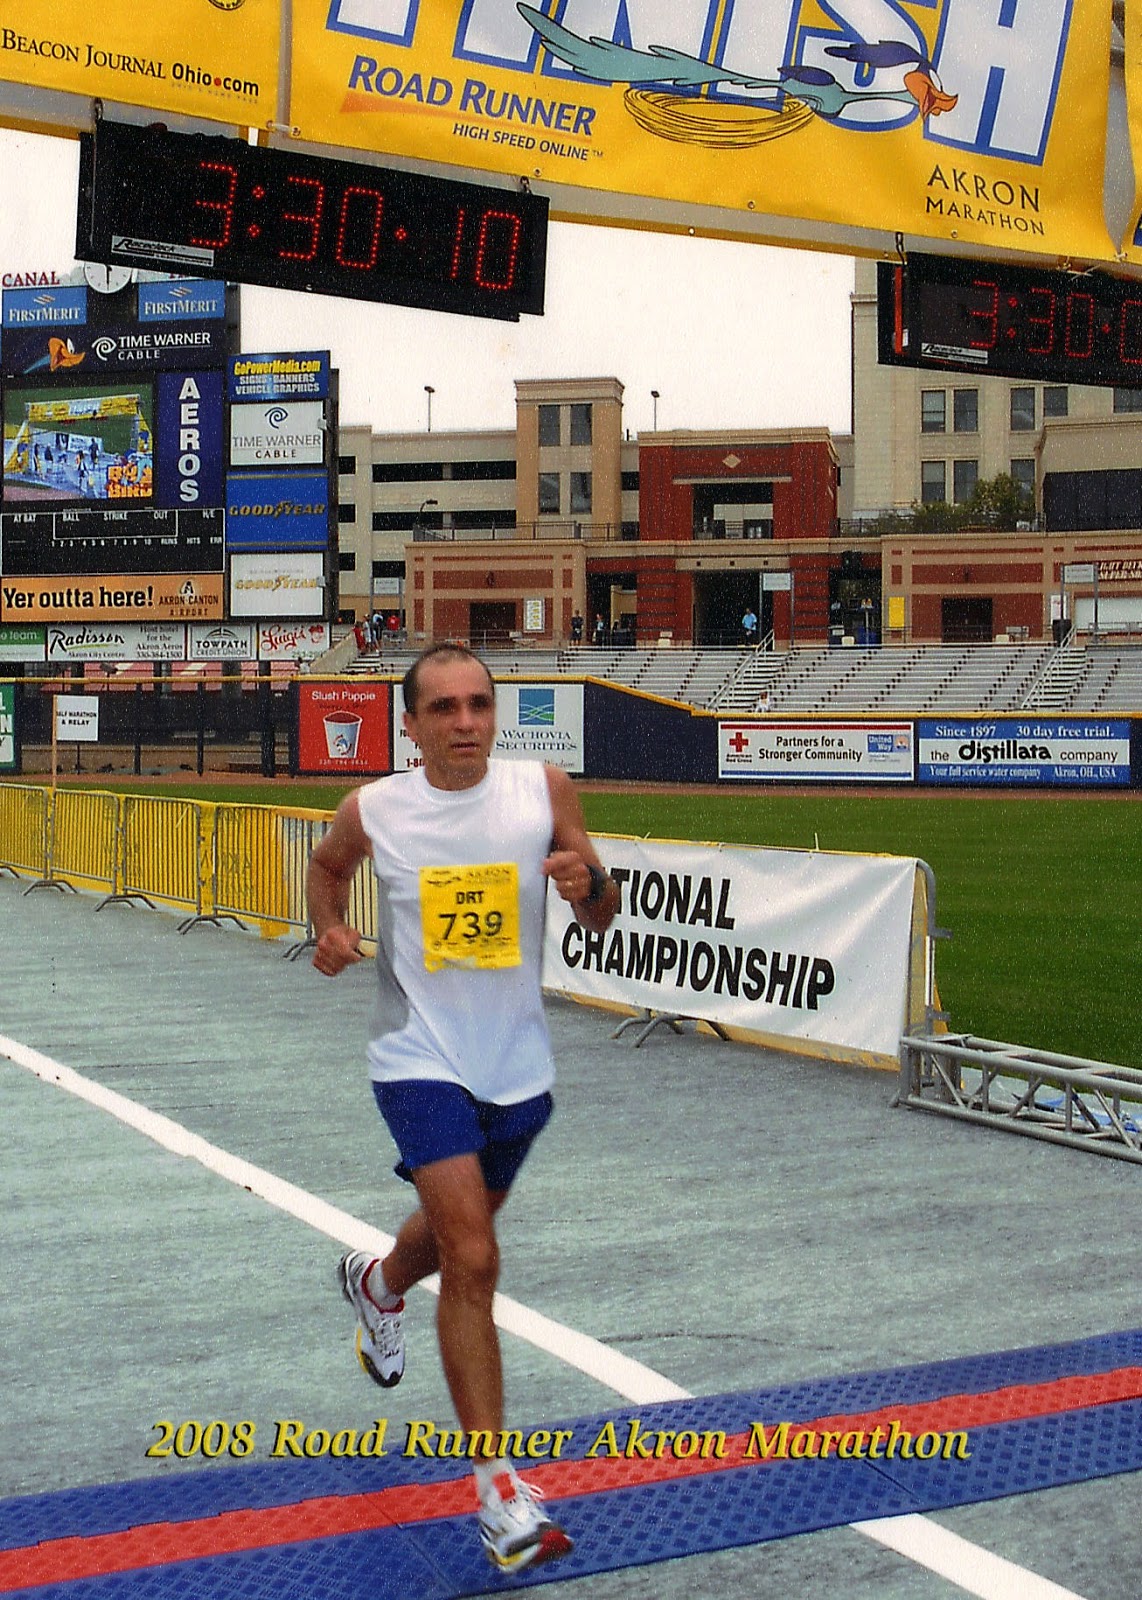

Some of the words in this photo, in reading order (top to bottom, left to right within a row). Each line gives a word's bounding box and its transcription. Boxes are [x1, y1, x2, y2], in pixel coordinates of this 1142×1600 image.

[1, 28, 79, 62] BEACON
[85, 44, 166, 79] JOURNAL
[172, 62, 259, 97] Ohio.com
[327, 0, 1073, 166] ISH
[348, 55, 453, 106] ROAD
[459, 78, 596, 136] RUNNER
[453, 123, 489, 141] HIGH
[492, 130, 536, 151] SPEED
[539, 140, 589, 161] ONLINE
[927, 164, 1039, 212] AKRON
[926, 196, 1045, 236] MARATHON
[2, 271, 60, 287] CANAL
[118, 335, 151, 348] TIME
[154, 332, 211, 345] WARNER
[118, 350, 161, 361] CABLE
[240, 375, 266, 384] SIGNS
[273, 373, 315, 383] BANNERS
[236, 385, 272, 394] VEHICLE
[273, 383, 320, 393] GRAPHICS
[178, 377, 201, 502] AEROS
[232, 436, 262, 447] TIME
[266, 434, 321, 446] WARNER
[255, 449, 297, 459] CABLE
[104, 511, 128, 521] STRIKE
[153, 510, 168, 519] OUT
[229, 501, 325, 518] GOODYEAR
[3, 587, 36, 609] Yer
[39, 587, 94, 609] outta
[99, 585, 154, 608] here!
[50, 626, 125, 654] Radisson
[160, 633, 171, 641] the
[195, 640, 248, 648] TOWPATH
[311, 690, 339, 701] Slush
[341, 691, 376, 703] Puppie
[502, 730, 572, 740] WACHOVIA
[935, 725, 967, 737] Since
[969, 726, 997, 737] 1897
[1016, 726, 1031, 737] 30
[1033, 726, 1053, 739] day
[1057, 726, 1082, 737] free
[1084, 725, 1115, 737] trial.
[496, 740, 577, 751] SECURITIES
[776, 735, 818, 748] Partners
[821, 735, 835, 747] for
[837, 738, 844, 747] a
[868, 735, 892, 743] United
[877, 743, 892, 752] Way
[930, 750, 950, 761] the
[958, 740, 1052, 763] distillata
[1060, 750, 1118, 763] company
[758, 748, 801, 763] Stronger
[804, 749, 863, 763] Community
[930, 765, 948, 777] Your
[949, 765, 962, 776] full
[962, 767, 987, 777] service
[988, 767, 1009, 777] water
[1009, 768, 1041, 779] company
[1099, 767, 1116, 778] USA
[607, 867, 736, 930] TIONAL
[438, 910, 503, 941] 739
[561, 921, 836, 1010] CHAMPIONSHIP
